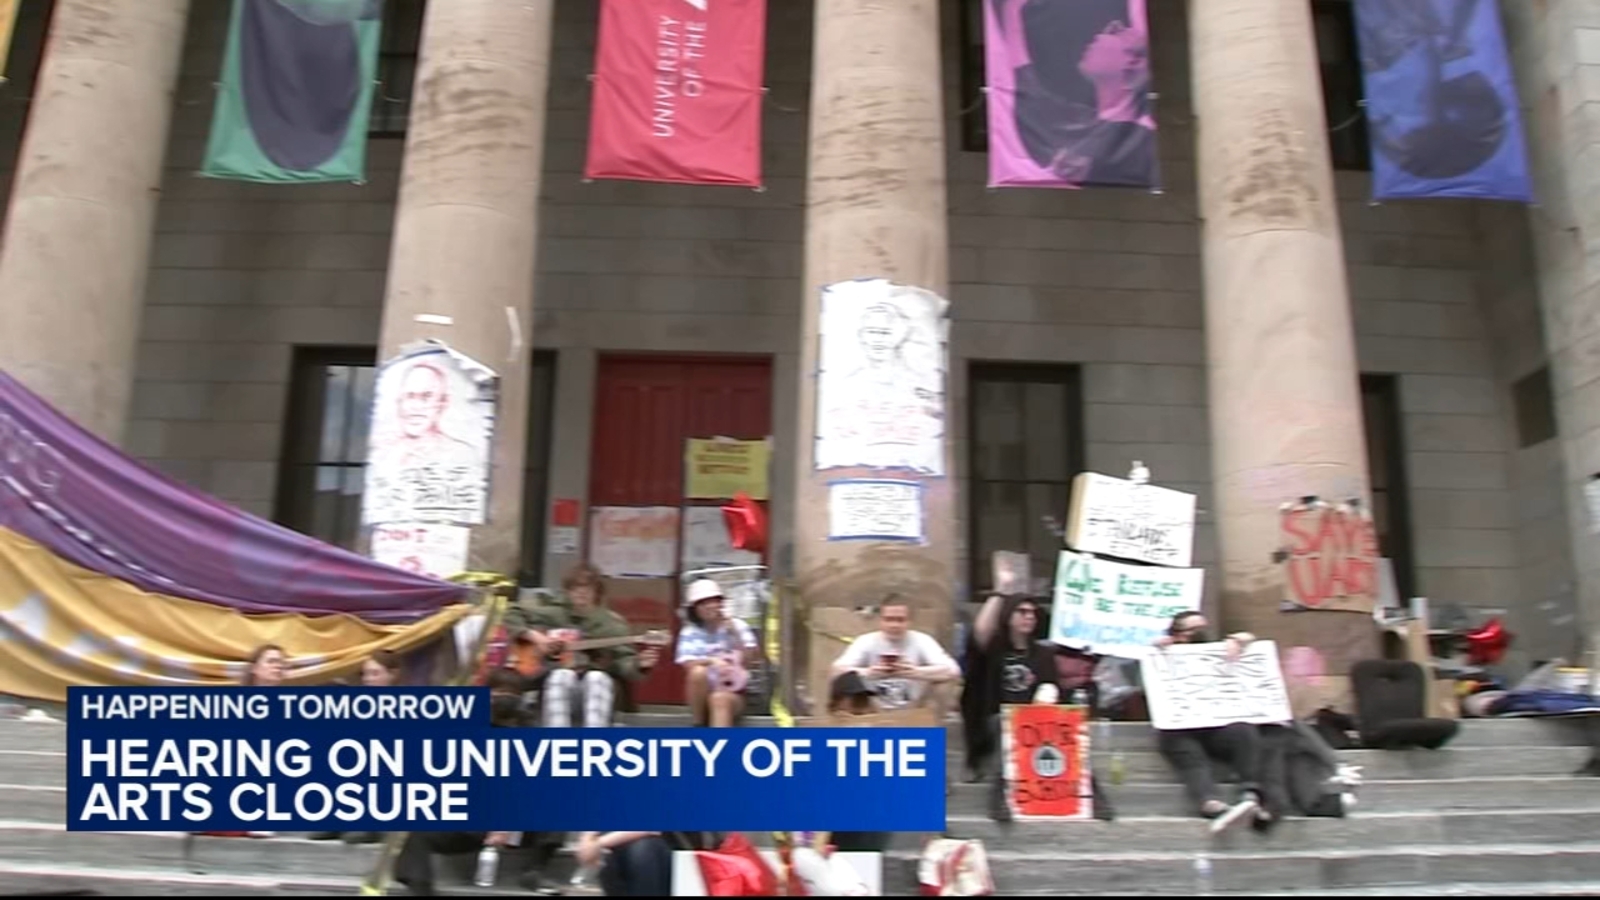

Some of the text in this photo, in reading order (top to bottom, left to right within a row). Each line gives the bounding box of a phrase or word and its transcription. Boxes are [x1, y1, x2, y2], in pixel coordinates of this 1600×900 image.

[683, 21, 707, 59] THE
[652, 15, 681, 137] UNIVERSITY
[681, 68, 704, 97] OF
